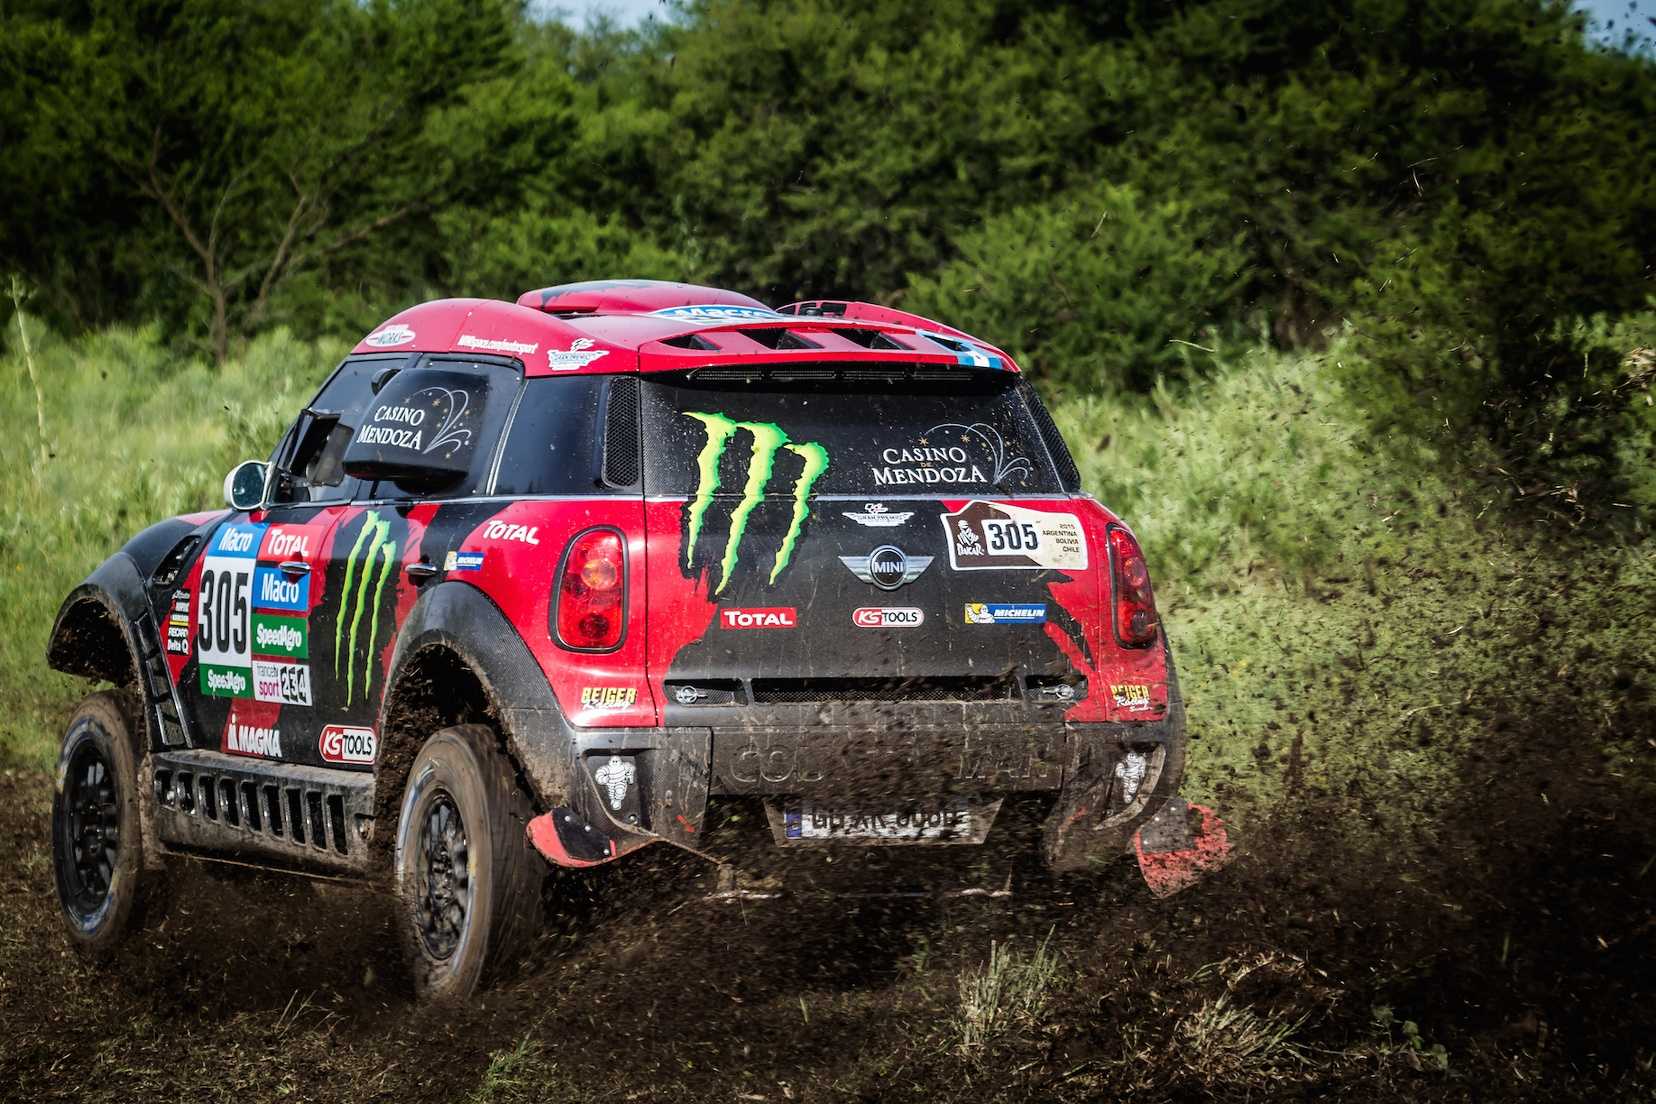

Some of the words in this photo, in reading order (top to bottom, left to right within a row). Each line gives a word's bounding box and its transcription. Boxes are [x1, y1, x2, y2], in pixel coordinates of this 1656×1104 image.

[374, 405, 425, 426] CASINO
[356, 424, 422, 450] MENDOZA
[883, 447, 966, 464] CASINO
[871, 464, 988, 486] MENDOZA
[219, 527, 253, 552] Macro
[268, 529, 310, 557] TOTAL
[483, 520, 540, 545] TOTAL
[988, 523, 1039, 550] 305
[956, 543, 984, 556] DAKAR
[874, 561, 904, 573] MINI
[261, 573, 299, 603] Macro
[198, 569, 249, 654] 305
[724, 609, 794, 626] TOTAL
[857, 610, 882, 624] KS
[882, 612, 918, 623] TOOLS
[994, 607, 1045, 617] MICHELIN
[256, 622, 302, 651] SpeedAgro
[259, 680, 280, 698] sport
[239, 724, 283, 758] MAGNA
[323, 731, 343, 755] KS
[343, 734, 373, 756] TOOLS
